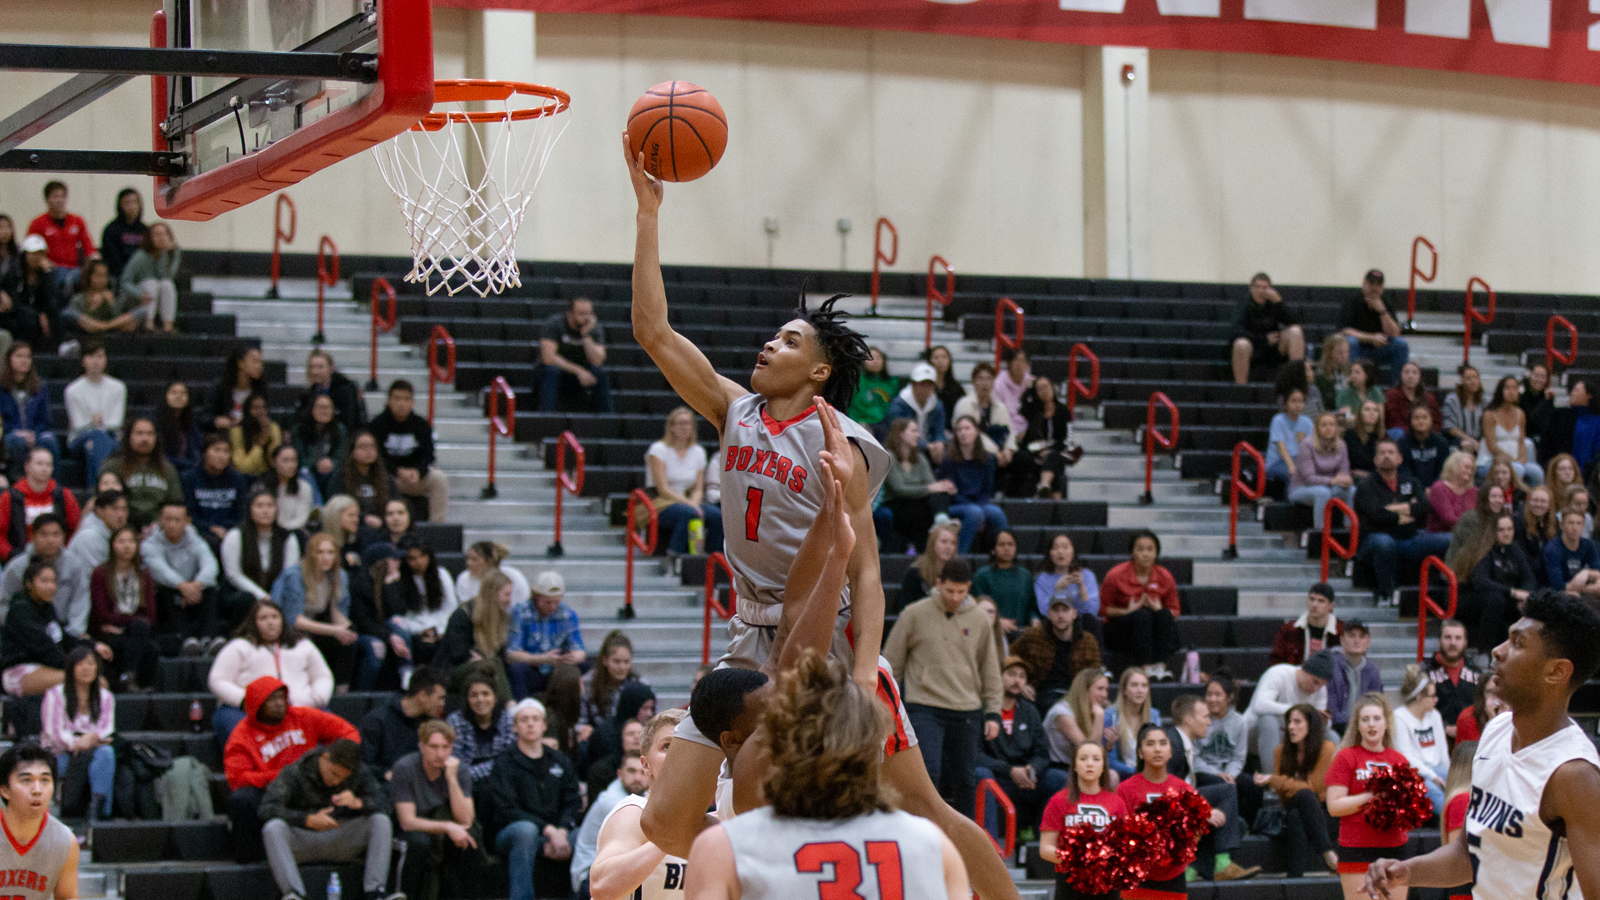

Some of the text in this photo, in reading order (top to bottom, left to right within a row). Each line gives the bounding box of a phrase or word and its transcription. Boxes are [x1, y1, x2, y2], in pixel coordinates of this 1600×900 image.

[724, 445, 808, 494] BOXERS
[745, 486, 764, 543] 1
[794, 841, 904, 900] 31
